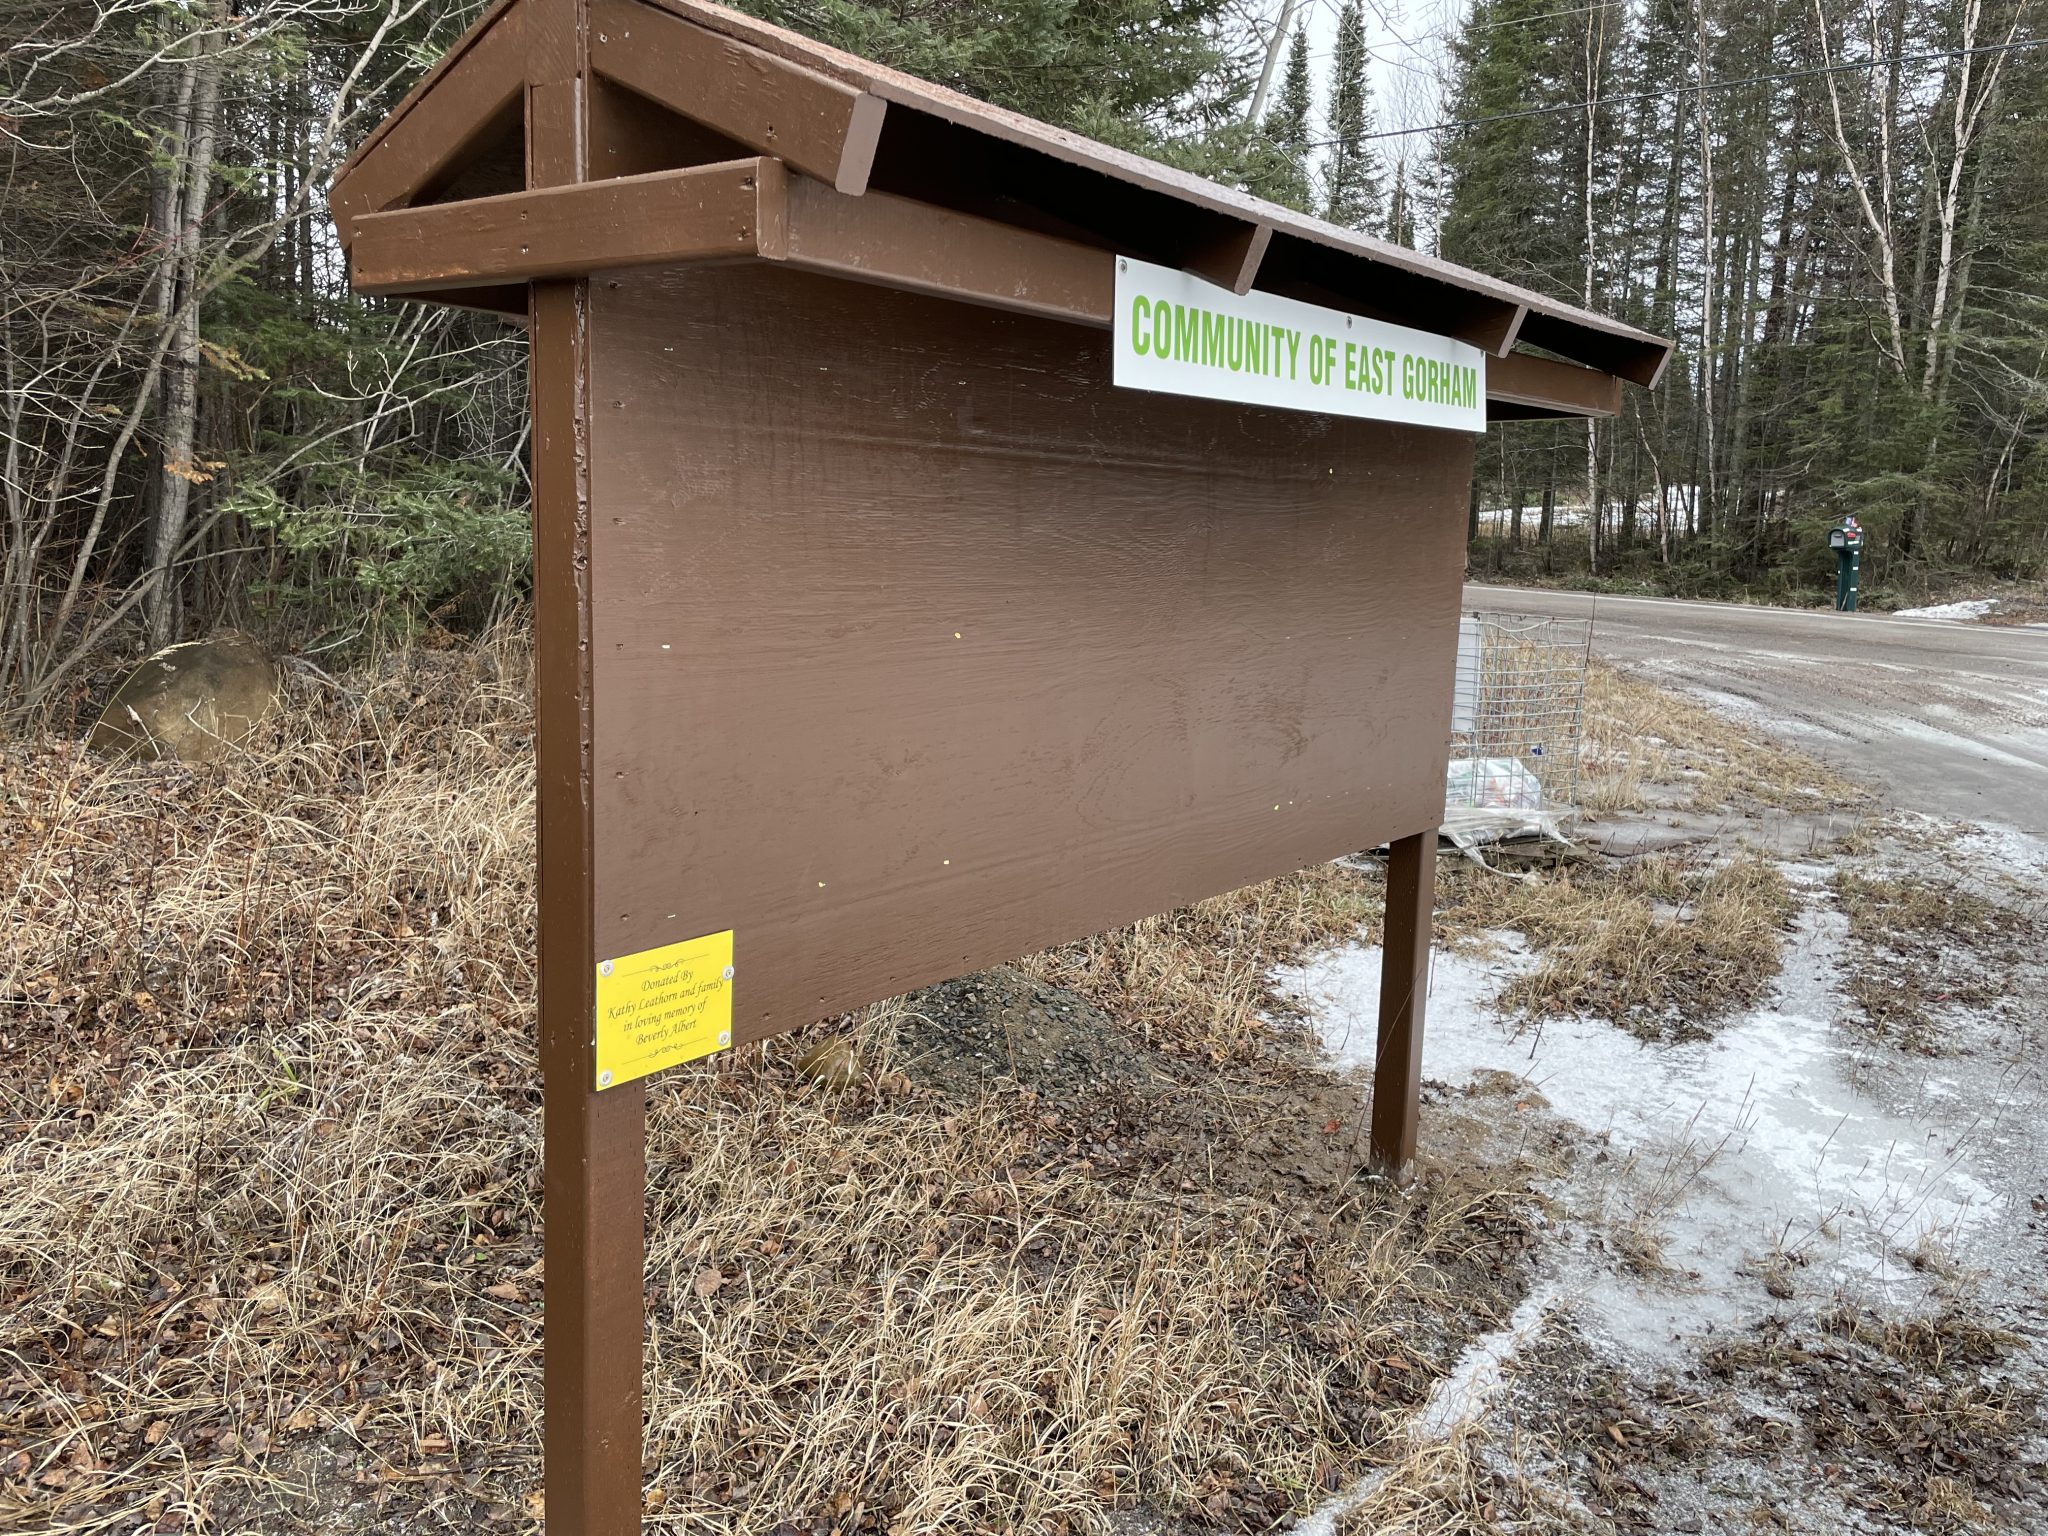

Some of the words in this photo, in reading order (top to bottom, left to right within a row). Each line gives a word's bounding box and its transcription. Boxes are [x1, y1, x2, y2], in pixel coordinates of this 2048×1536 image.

[1132, 295, 1300, 380] COMMUNITY
[1309, 334, 1336, 386] OF
[1344, 342, 1395, 396] EAST
[1402, 354, 1477, 409] GORHAM
[607, 1000, 637, 1019] Kathy
[638, 992, 678, 1010] Leathorn
[679, 983, 695, 999] and
[696, 977, 724, 998] family
[641, 972, 678, 992] Donated
[680, 970, 694, 983] By
[623, 1020, 632, 1032] in
[634, 1011, 662, 1028] loving
[664, 1003, 696, 1019] memory
[697, 996, 709, 1014] of
[635, 1028, 670, 1045] Beverly
[671, 1019, 697, 1035] Albert
